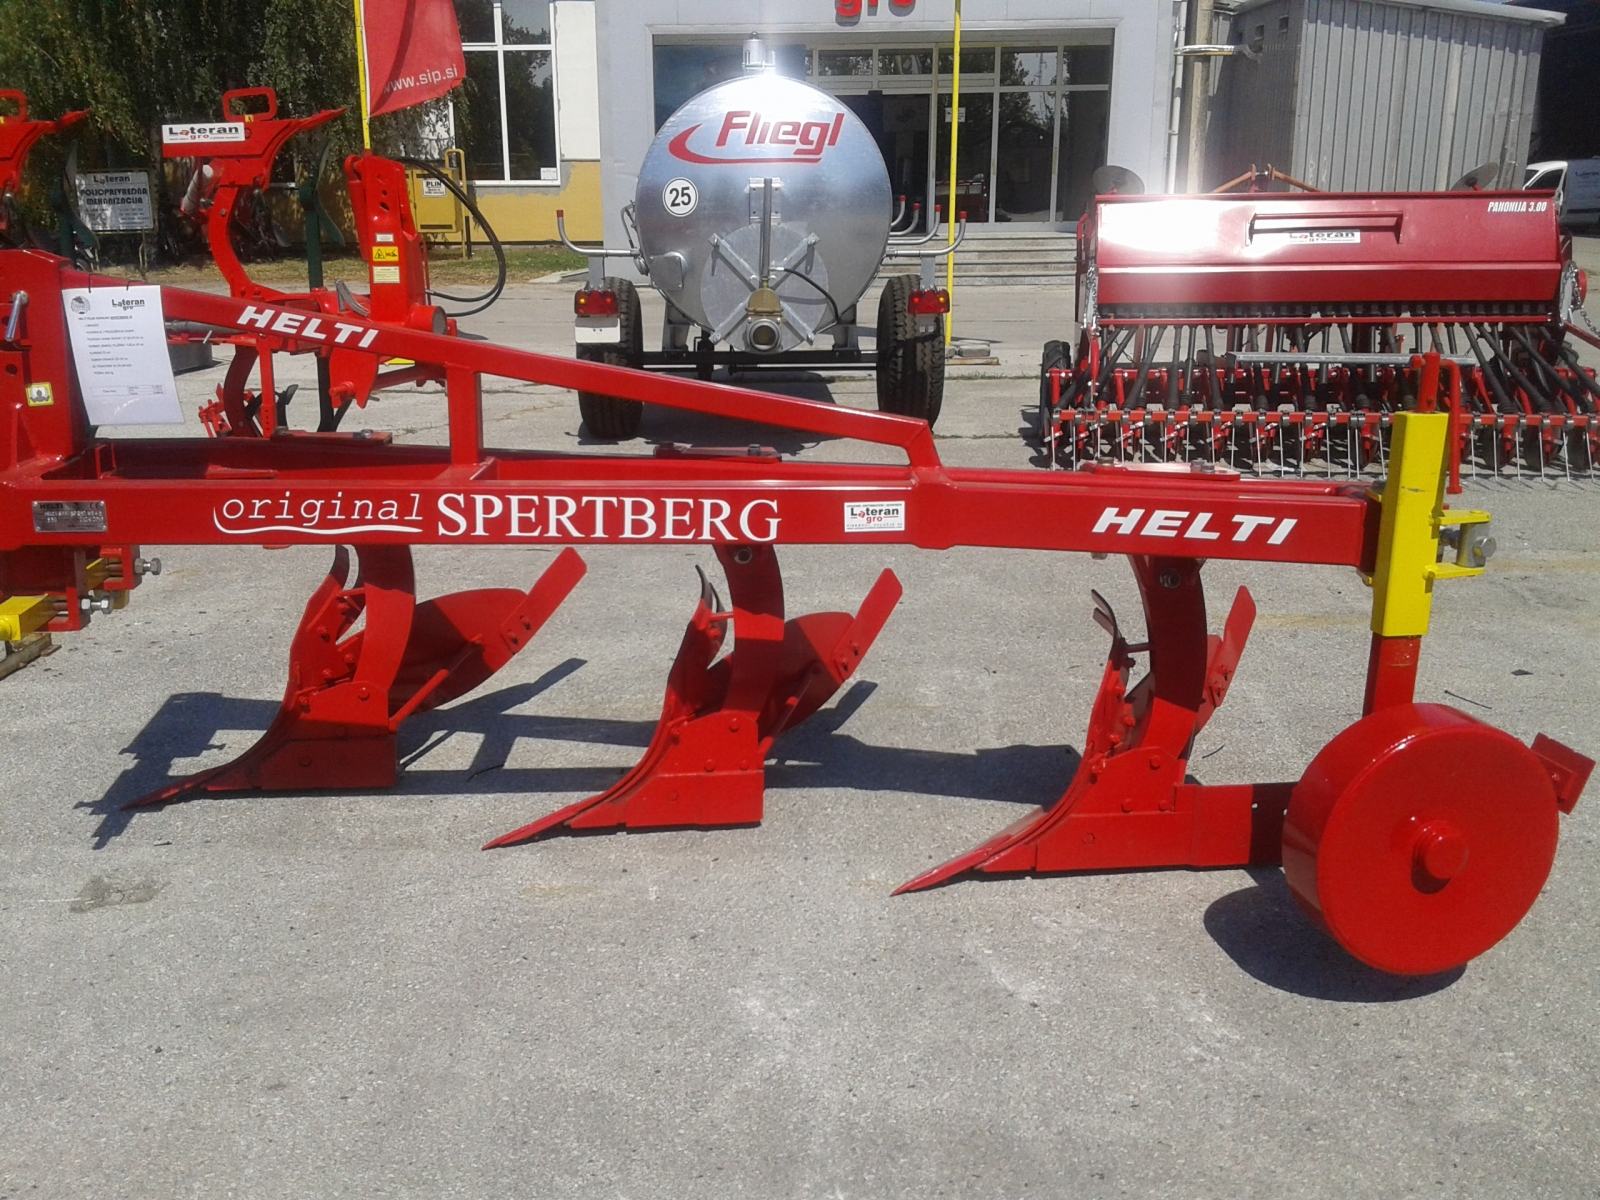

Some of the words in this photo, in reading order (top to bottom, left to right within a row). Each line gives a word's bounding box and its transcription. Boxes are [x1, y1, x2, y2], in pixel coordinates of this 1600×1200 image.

[168, 126, 240, 136] Lateran
[715, 111, 845, 156] Fliegl
[669, 186, 692, 207] 25
[1487, 201, 1527, 212] PANONIJA
[1528, 201, 1548, 212] 3.00
[111, 299, 145, 308] Lateran
[236, 305, 379, 349] HELTI
[222, 491, 424, 528] original
[437, 493, 783, 542] SPERTBERG
[850, 507, 900, 518] Lateran
[1091, 507, 1298, 545] HELTI
